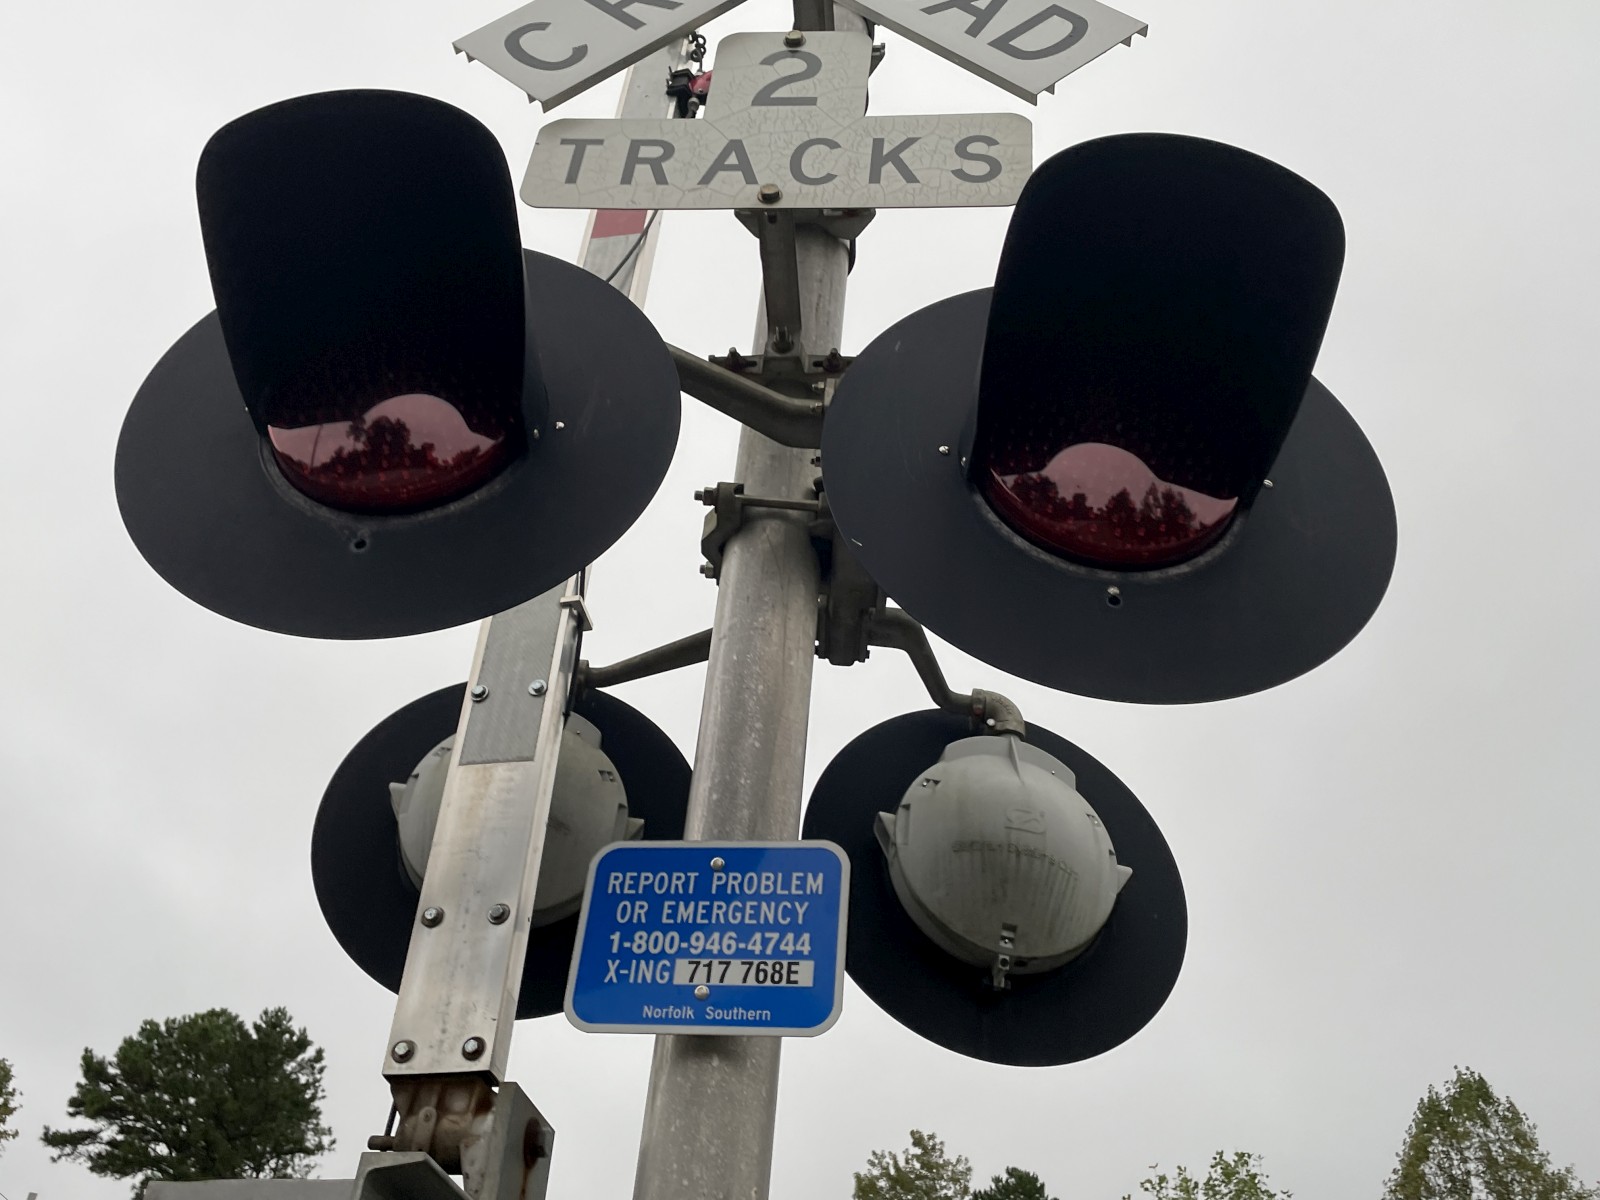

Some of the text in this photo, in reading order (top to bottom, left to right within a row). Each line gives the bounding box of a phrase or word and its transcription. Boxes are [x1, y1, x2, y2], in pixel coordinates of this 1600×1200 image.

[751, 49, 822, 106] 2
[559, 135, 1003, 185] TRACKS
[607, 872, 824, 895] REPORT PROBLEM
[616, 901, 809, 925] OR EMERGENCY
[609, 931, 812, 955] 1-800-946-4744
[604, 960, 800, 985] X-ING 717 768E
[642, 1005, 771, 1021] Norfolk Southern
